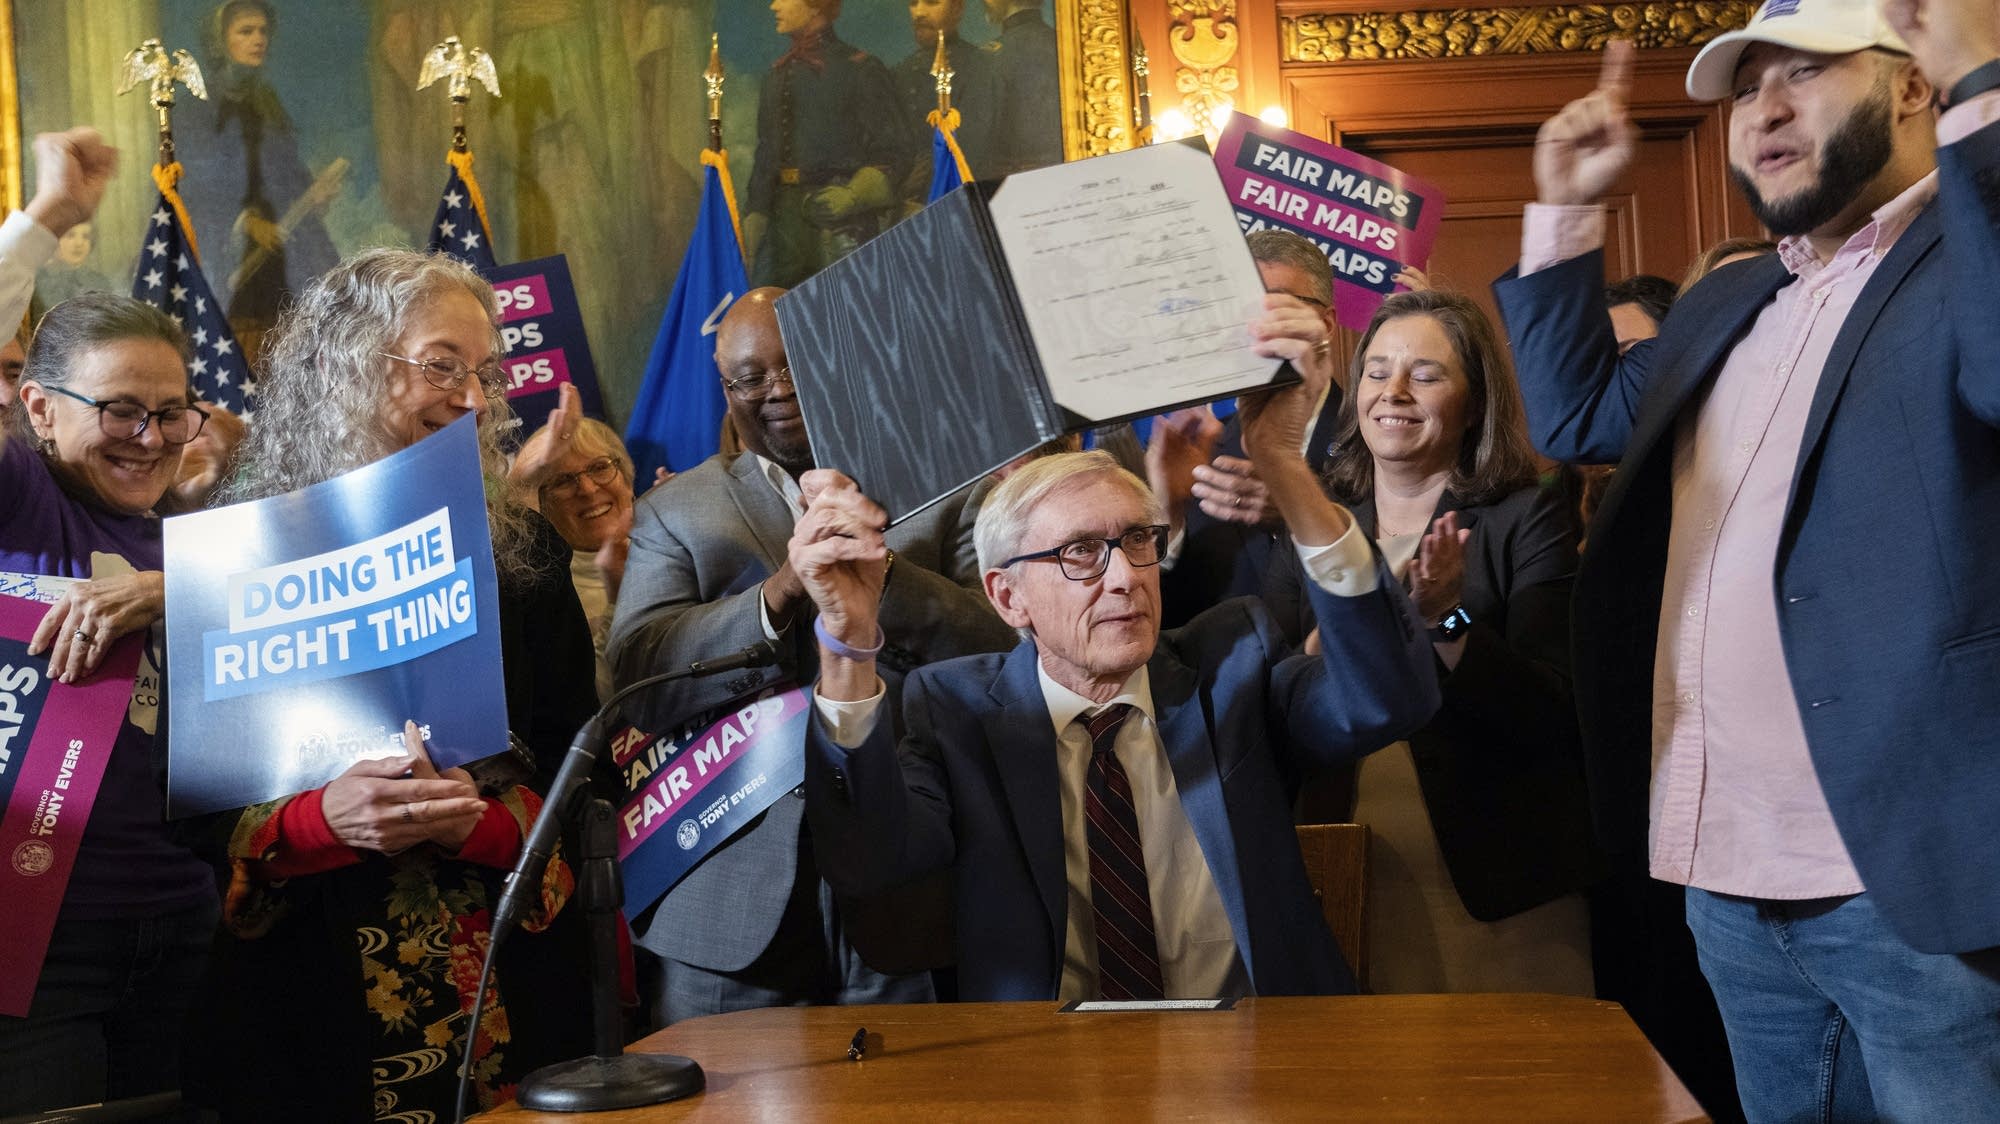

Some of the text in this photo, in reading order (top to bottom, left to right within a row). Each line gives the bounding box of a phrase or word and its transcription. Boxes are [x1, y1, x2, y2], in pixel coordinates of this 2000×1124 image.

[1239, 178, 1398, 251] FAIR MAPS
[1253, 143, 1411, 217] FAIR MAPS
[243, 525, 445, 619] DOING THE
[214, 579, 472, 685] RIGHT THING
[0, 664, 39, 774] APS
[38, 738, 84, 836] TONY EVERS
[624, 688, 785, 840] FAIR MAPS
[700, 773, 767, 829] TONY EVERS
[30, 789, 51, 834] GOVERNOR
[698, 794, 727, 820] GOVERNOR
